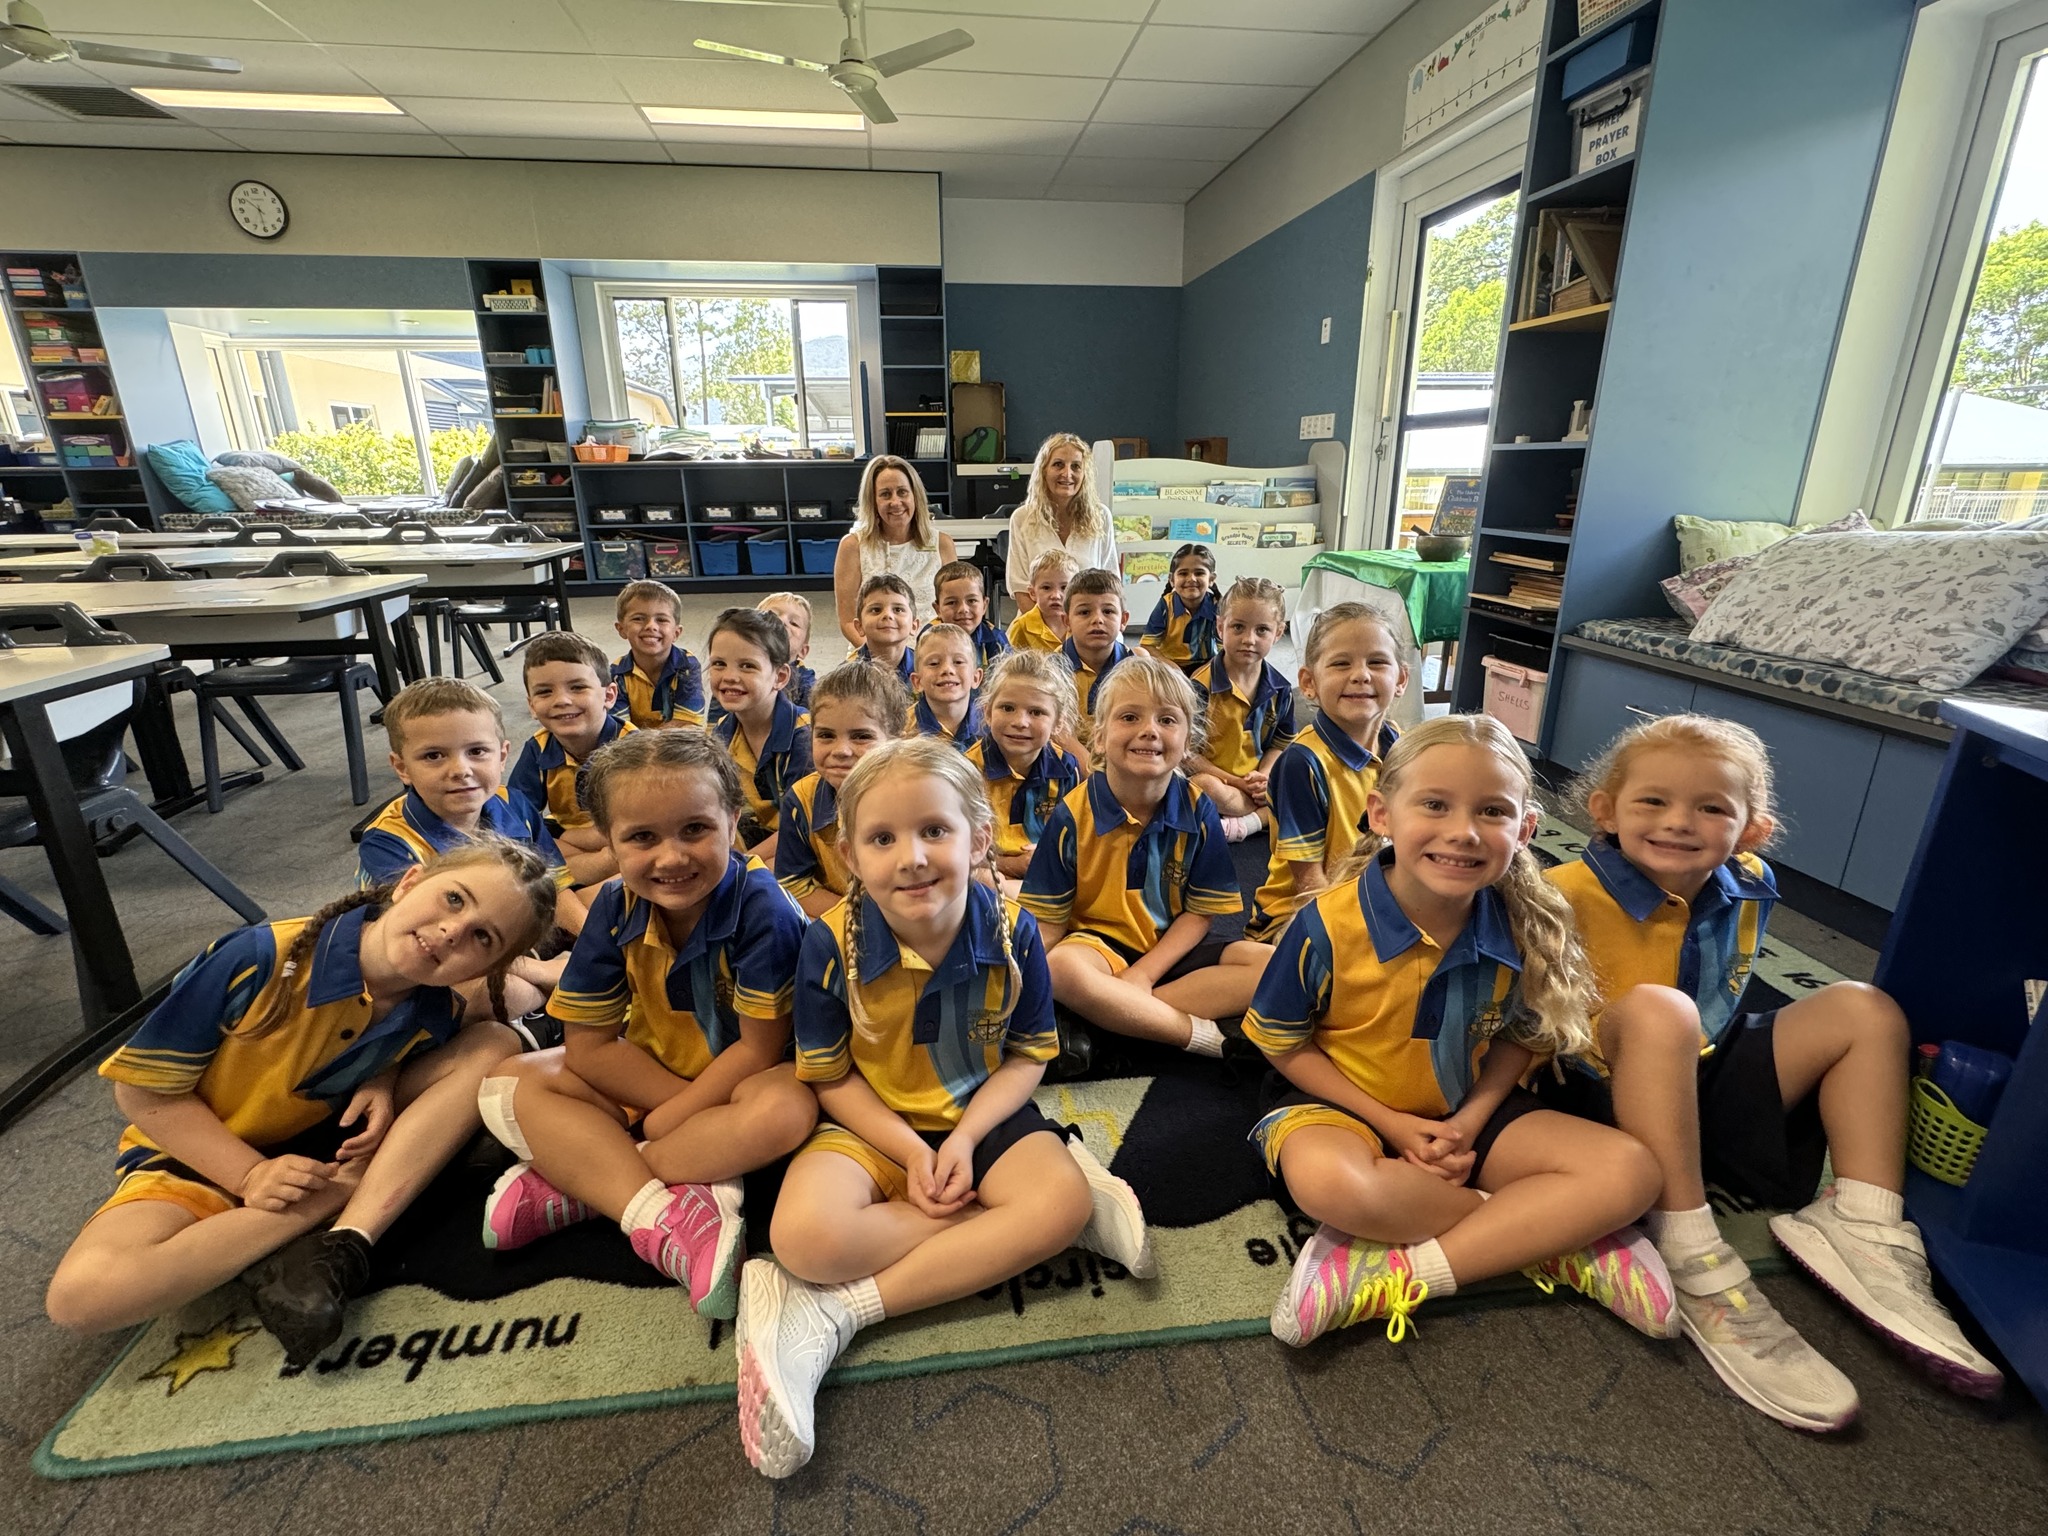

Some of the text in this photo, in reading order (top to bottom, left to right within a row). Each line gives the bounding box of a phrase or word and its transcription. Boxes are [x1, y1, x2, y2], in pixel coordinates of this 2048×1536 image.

[1589, 124, 1630, 153] PRAYER
[1595, 146, 1618, 167] BOX
[1164, 488, 1203, 497] BLOSSOM
[1498, 691, 1530, 711] SHELLS
[976, 1253, 1130, 1317] circl
[278, 1312, 583, 1384] number
